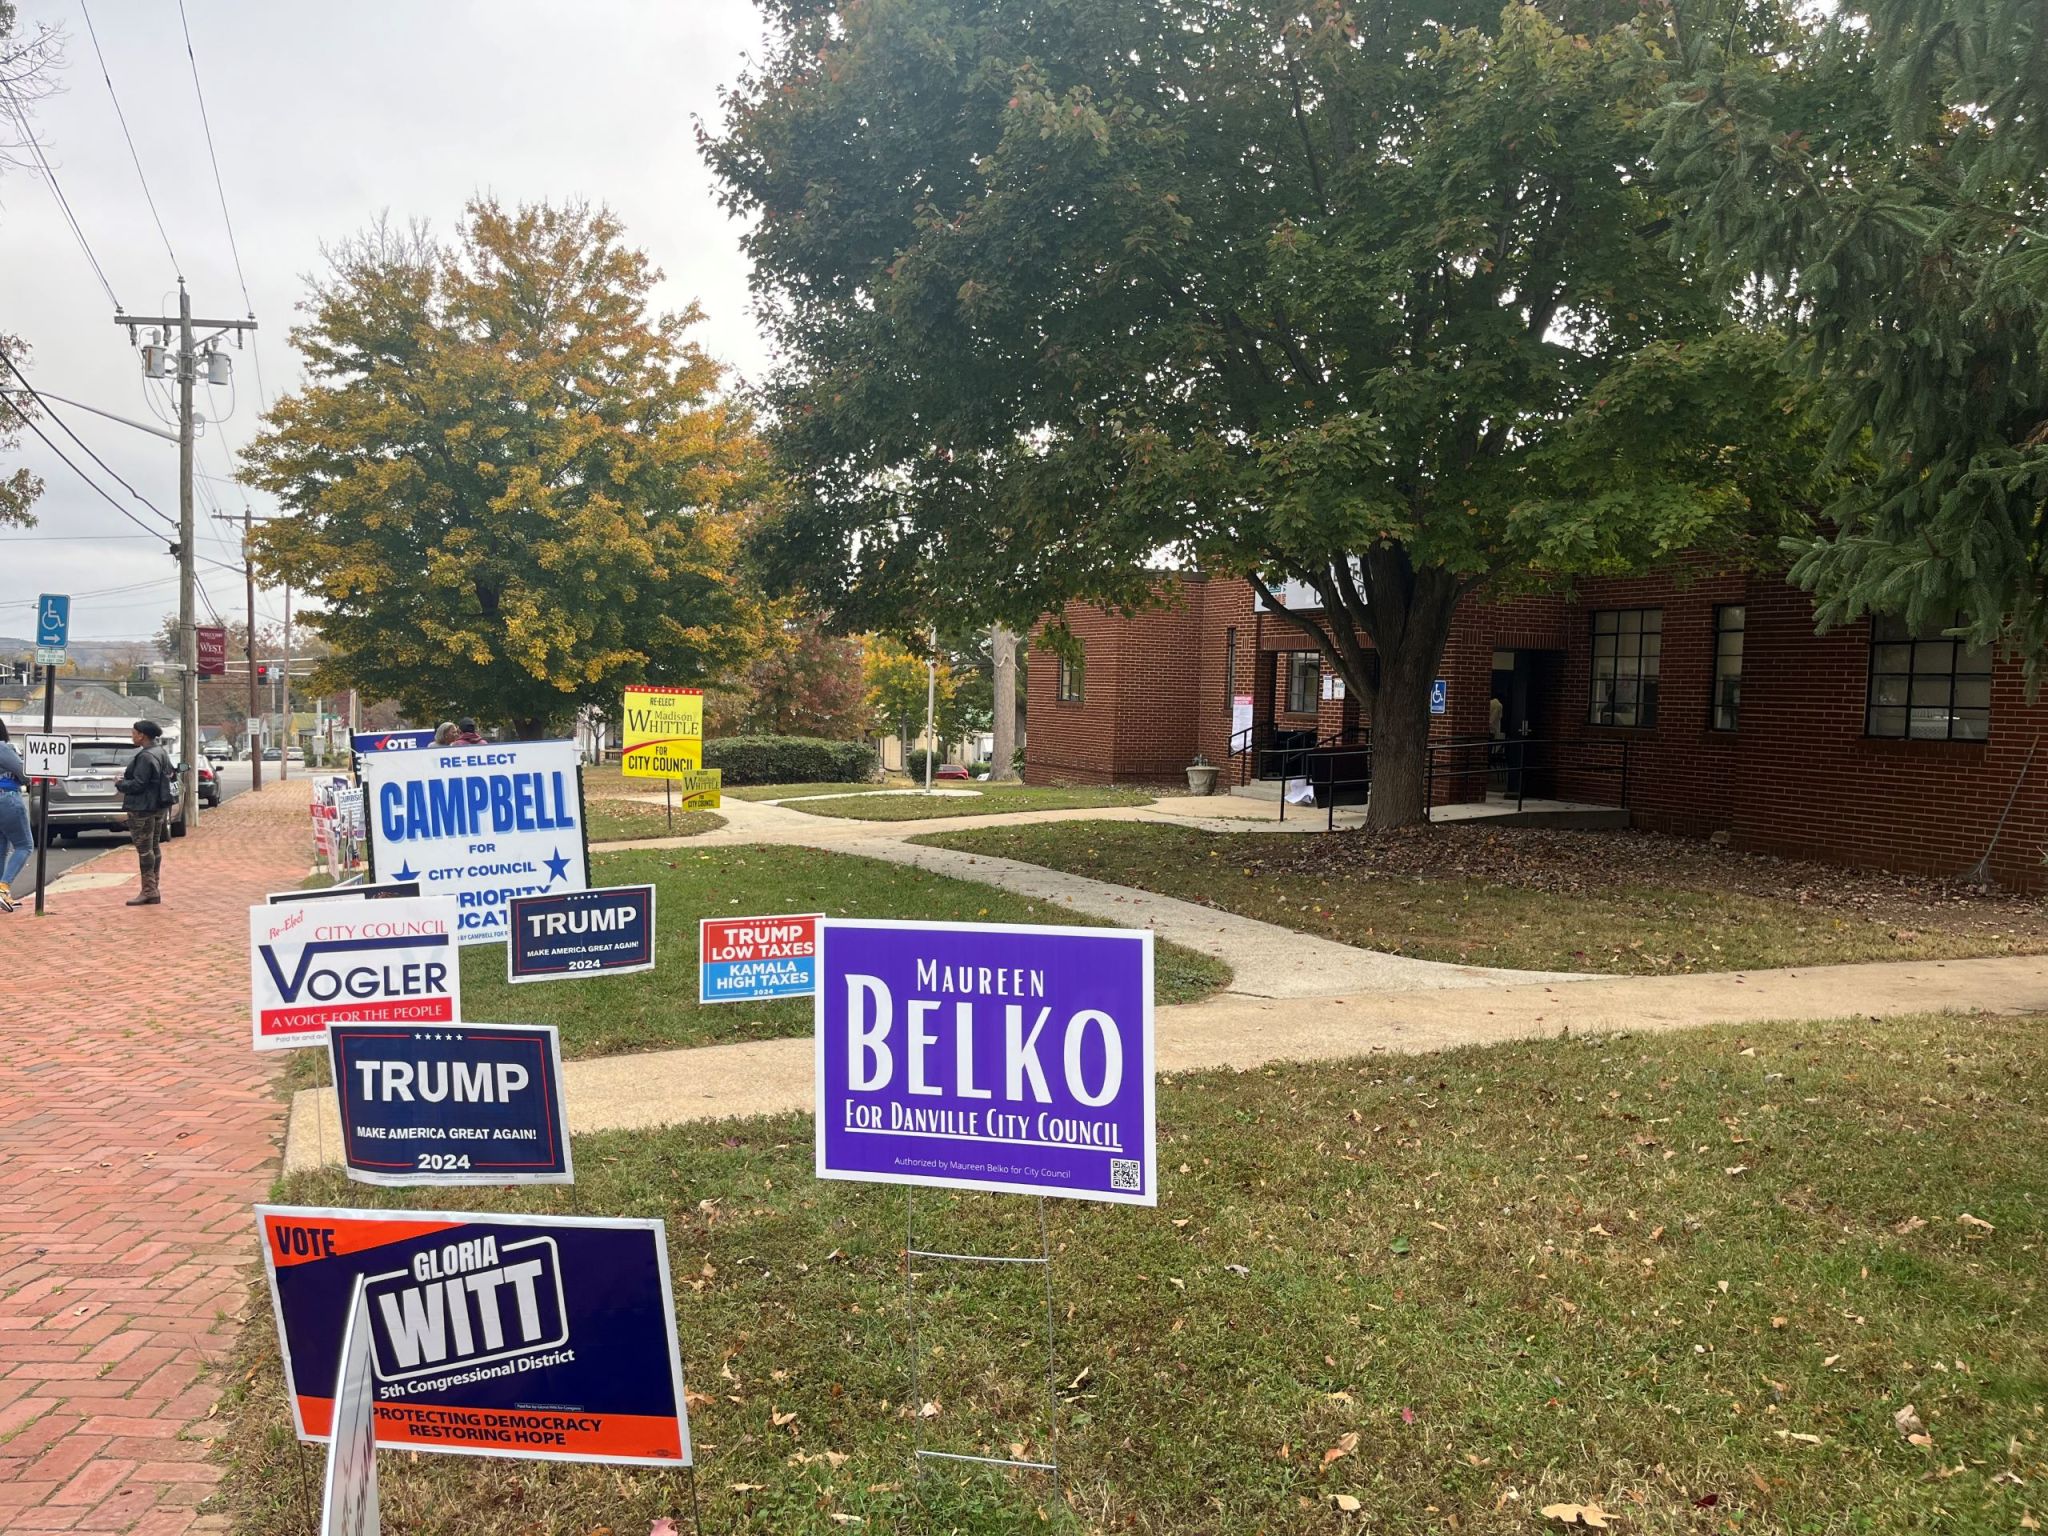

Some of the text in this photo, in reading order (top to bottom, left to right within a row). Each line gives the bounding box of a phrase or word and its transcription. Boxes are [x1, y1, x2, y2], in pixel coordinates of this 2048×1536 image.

[200, 642, 222, 652] WEST
[650, 697, 675, 706] RE-ELECT
[628, 709, 699, 736] WHITTLE
[655, 710, 692, 721] Madison
[29, 741, 66, 755] WARD
[656, 746, 668, 756] FOR
[43, 758, 49, 771] 1
[440, 753, 516, 768] RE-ELECT
[629, 756, 650, 770] CITY
[380, 771, 575, 843] CAMPBELL
[469, 843, 496, 854] FOR
[428, 862, 537, 881] CITY COUNCIL
[269, 910, 304, 940] Re-Elect
[315, 920, 448, 941] CITY COUNCIL
[527, 906, 637, 938] TRUMP
[468, 932, 493, 940] CAMPBELL
[724, 925, 803, 945] TRUMP
[527, 940, 639, 958] MAKE AMERICA GREAT AGAIN!
[712, 941, 814, 961] LOW TAXES
[258, 938, 448, 1004] VOGLER
[568, 959, 601, 970] 2024
[730, 961, 797, 976] KAMALA
[717, 972, 809, 990] HIGH TAXES
[917, 958, 1045, 997] MAUREEN
[271, 1004, 442, 1028] A VOICE FOR THE PEOPLE
[845, 973, 1123, 1107] BELKO
[356, 1060, 529, 1103] TRUMP
[357, 1126, 537, 1140] MAKE AMERICA GREAT AGAIN!
[845, 1099, 1122, 1147] FOR DANVILLE CITY COUNCIL
[418, 1153, 471, 1170] 2024
[894, 1157, 1071, 1179] Authorized by Maureen Belko for City Council
[275, 1226, 337, 1257] VOTE
[413, 1235, 499, 1282] GLORIA
[378, 1259, 543, 1369] WITT
[380, 1349, 575, 1400] 5th Congressional District
[485, 1414, 602, 1433] DEMOCRACY
[409, 1424, 567, 1446] RESTORING HOPE
